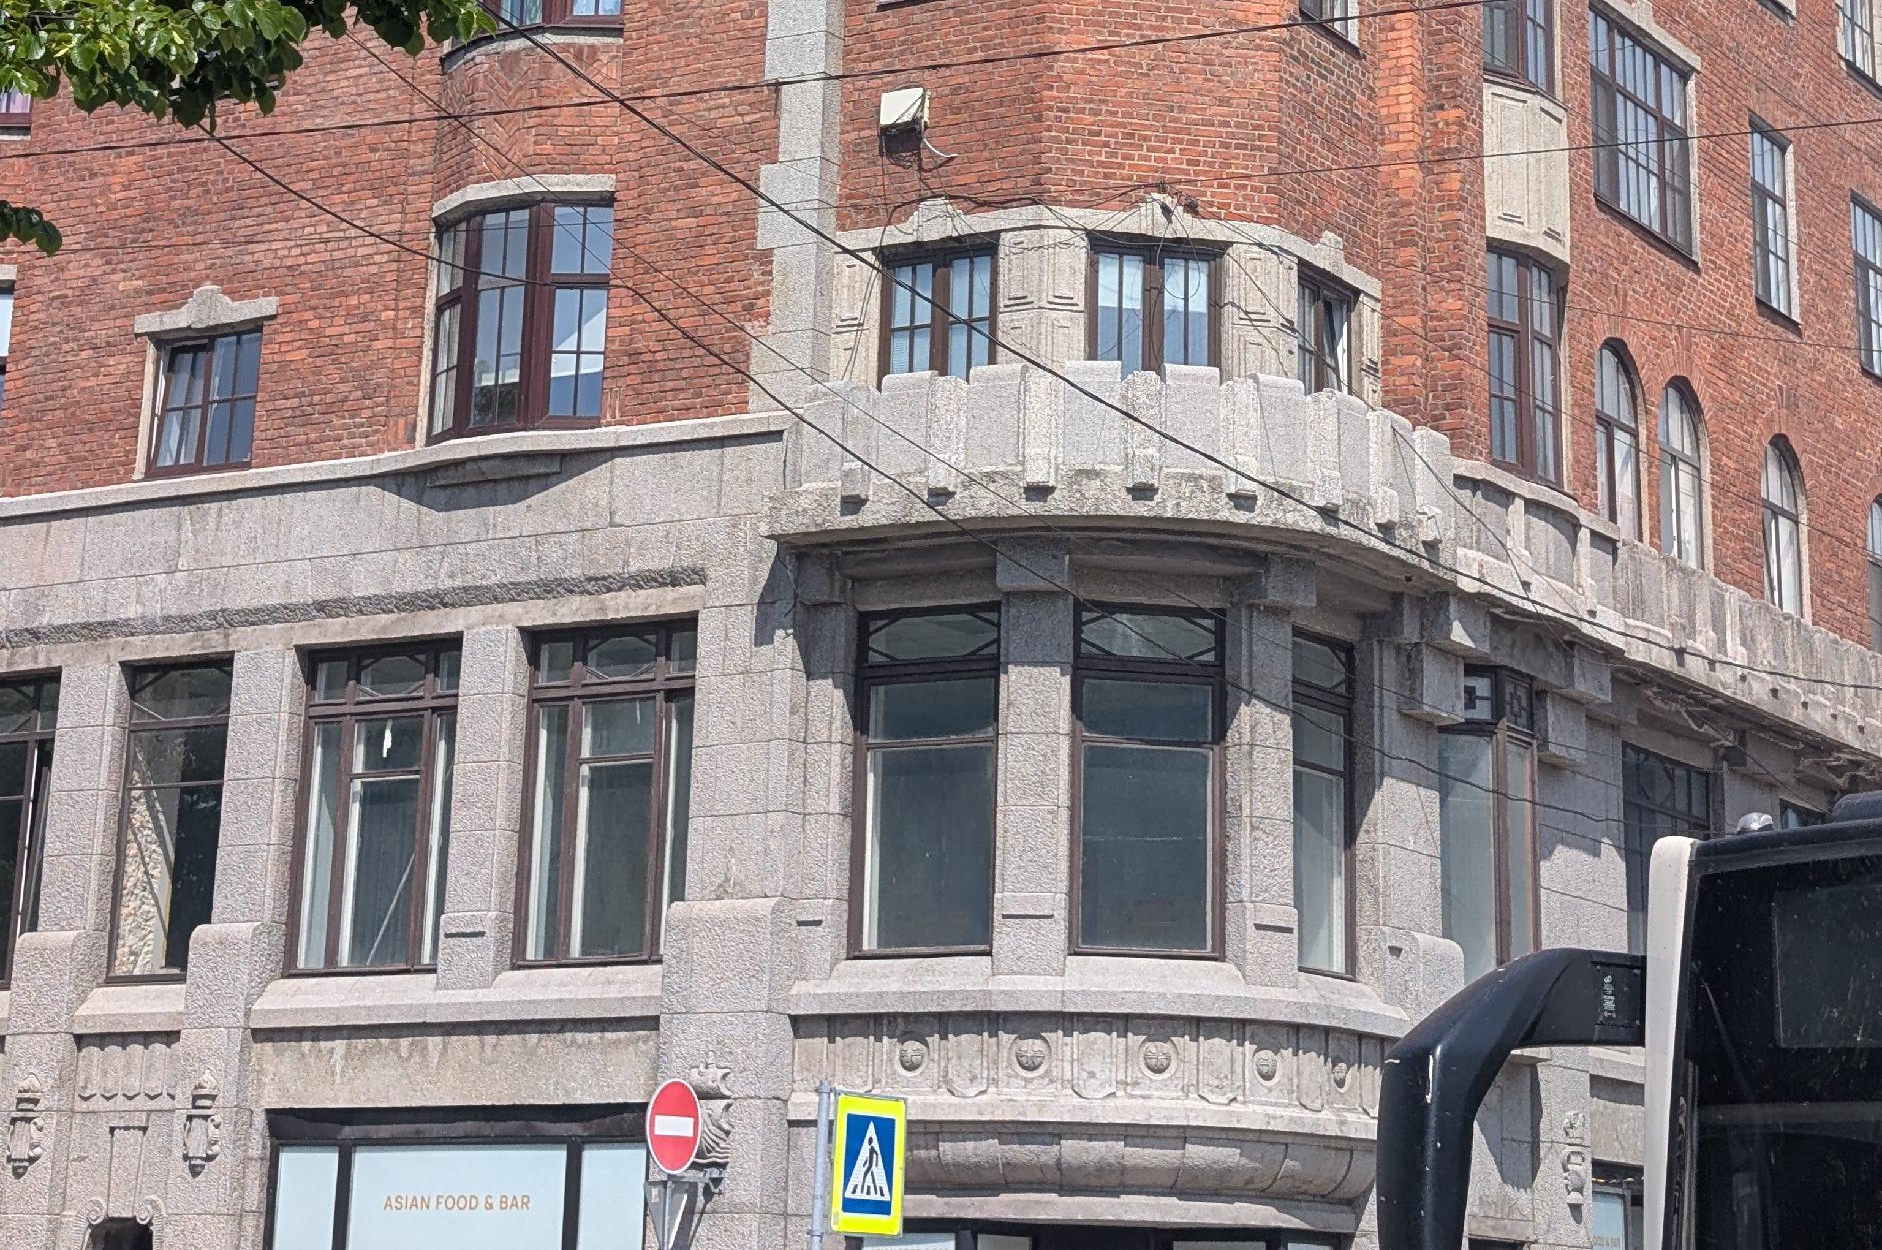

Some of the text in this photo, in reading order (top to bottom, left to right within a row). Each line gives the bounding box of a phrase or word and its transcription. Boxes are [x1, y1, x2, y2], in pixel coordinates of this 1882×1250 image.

[383, 1194, 531, 1211] ASIAN FOOD & BAR
